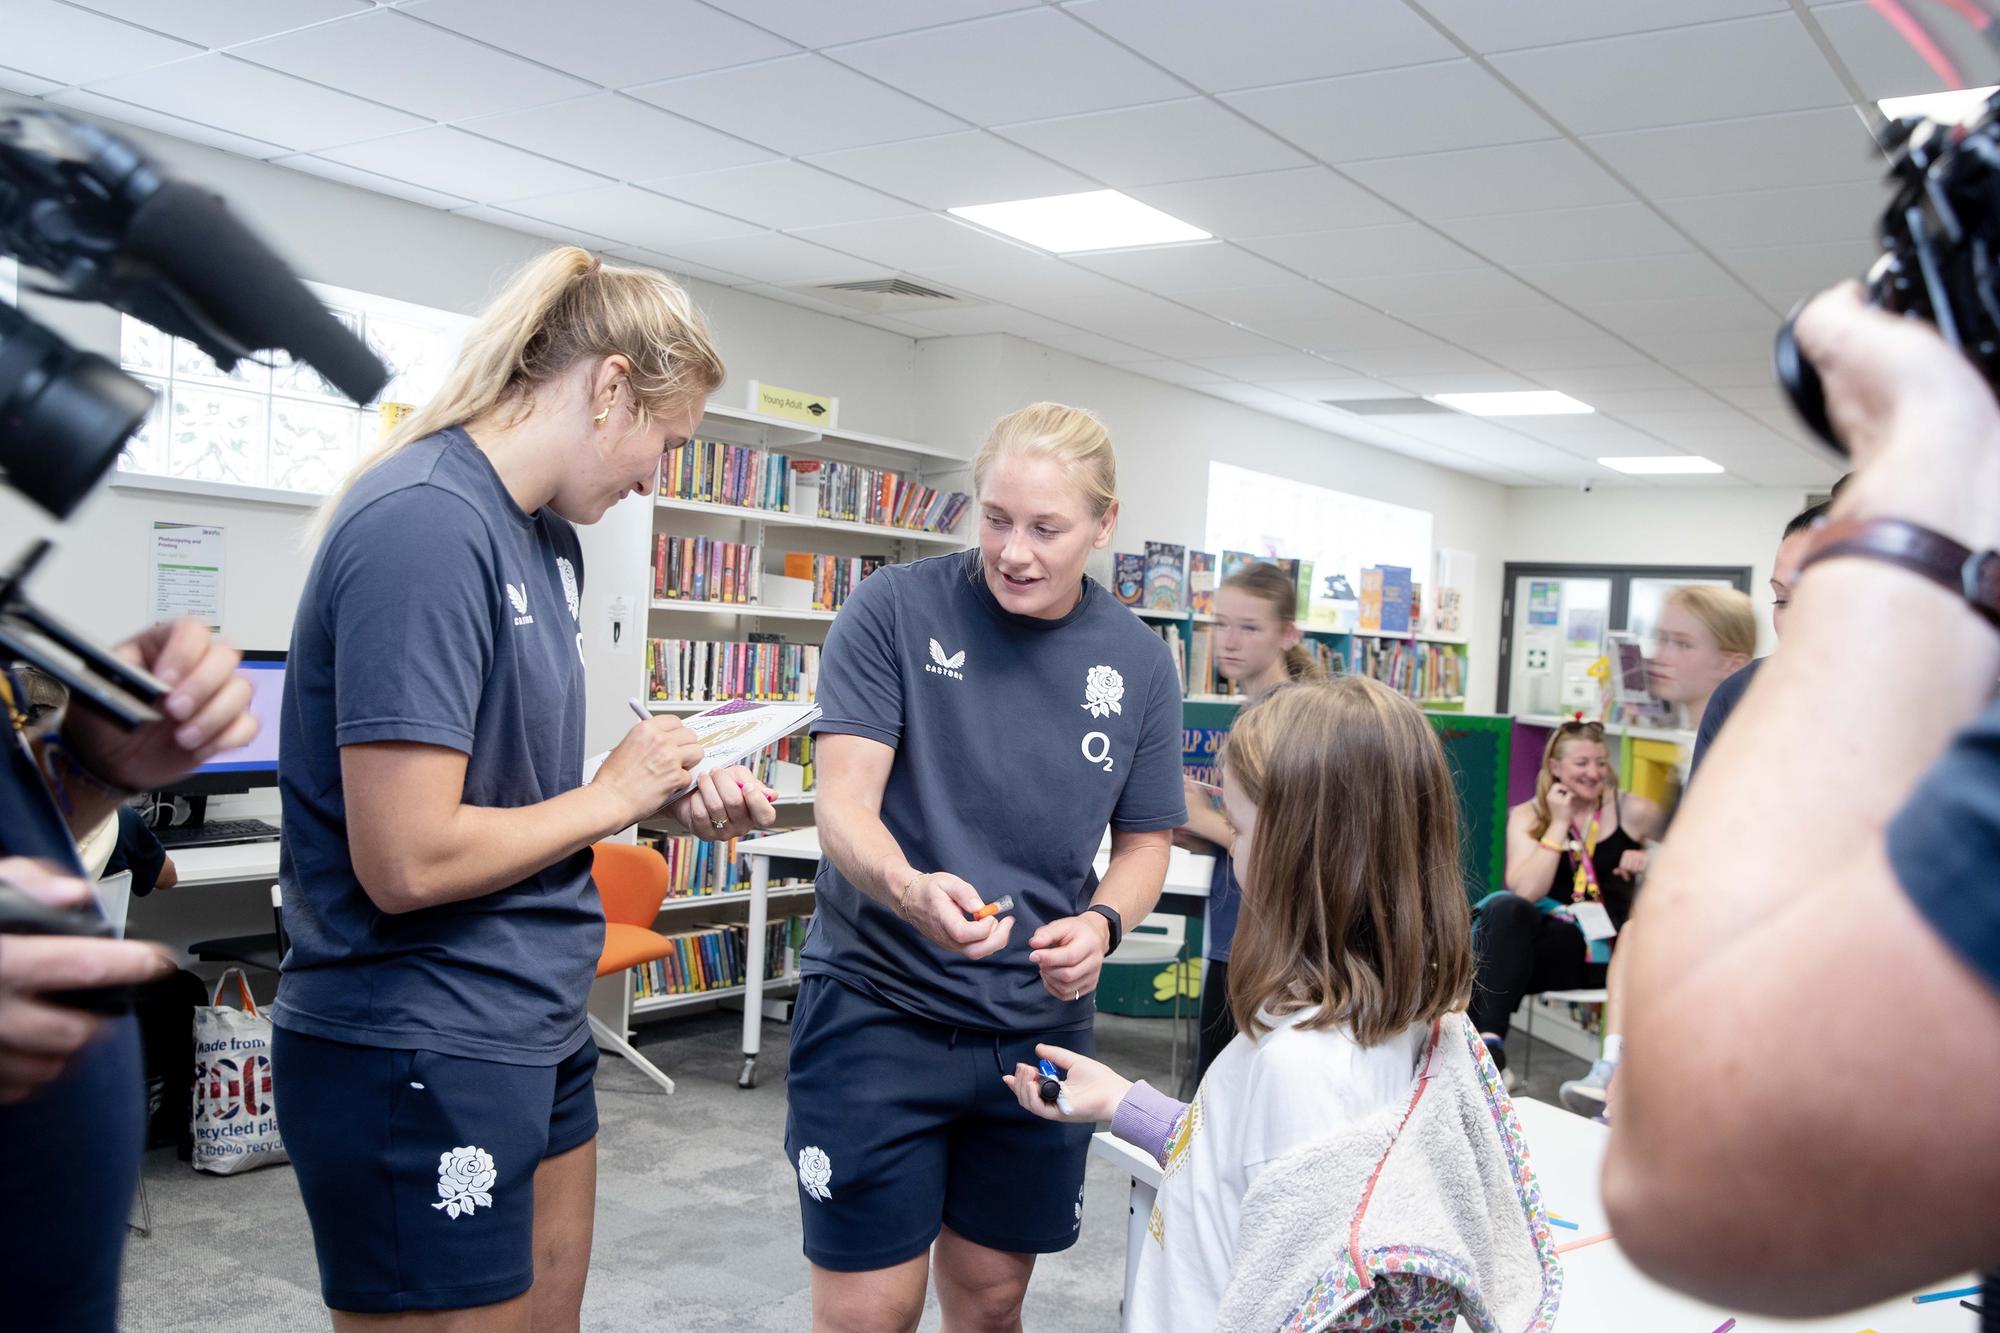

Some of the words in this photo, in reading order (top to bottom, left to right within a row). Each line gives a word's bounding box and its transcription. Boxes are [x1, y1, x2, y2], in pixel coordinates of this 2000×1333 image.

[763, 392, 784, 408] Young
[785, 398, 802, 410] Adult
[158, 536, 191, 544] Photocopying
[925, 663, 964, 681] CASTORE
[197, 1040, 227, 1054] Made
[230, 1037, 266, 1050] from
[197, 1121, 255, 1142] recycled
[206, 1143, 243, 1157] 100%
